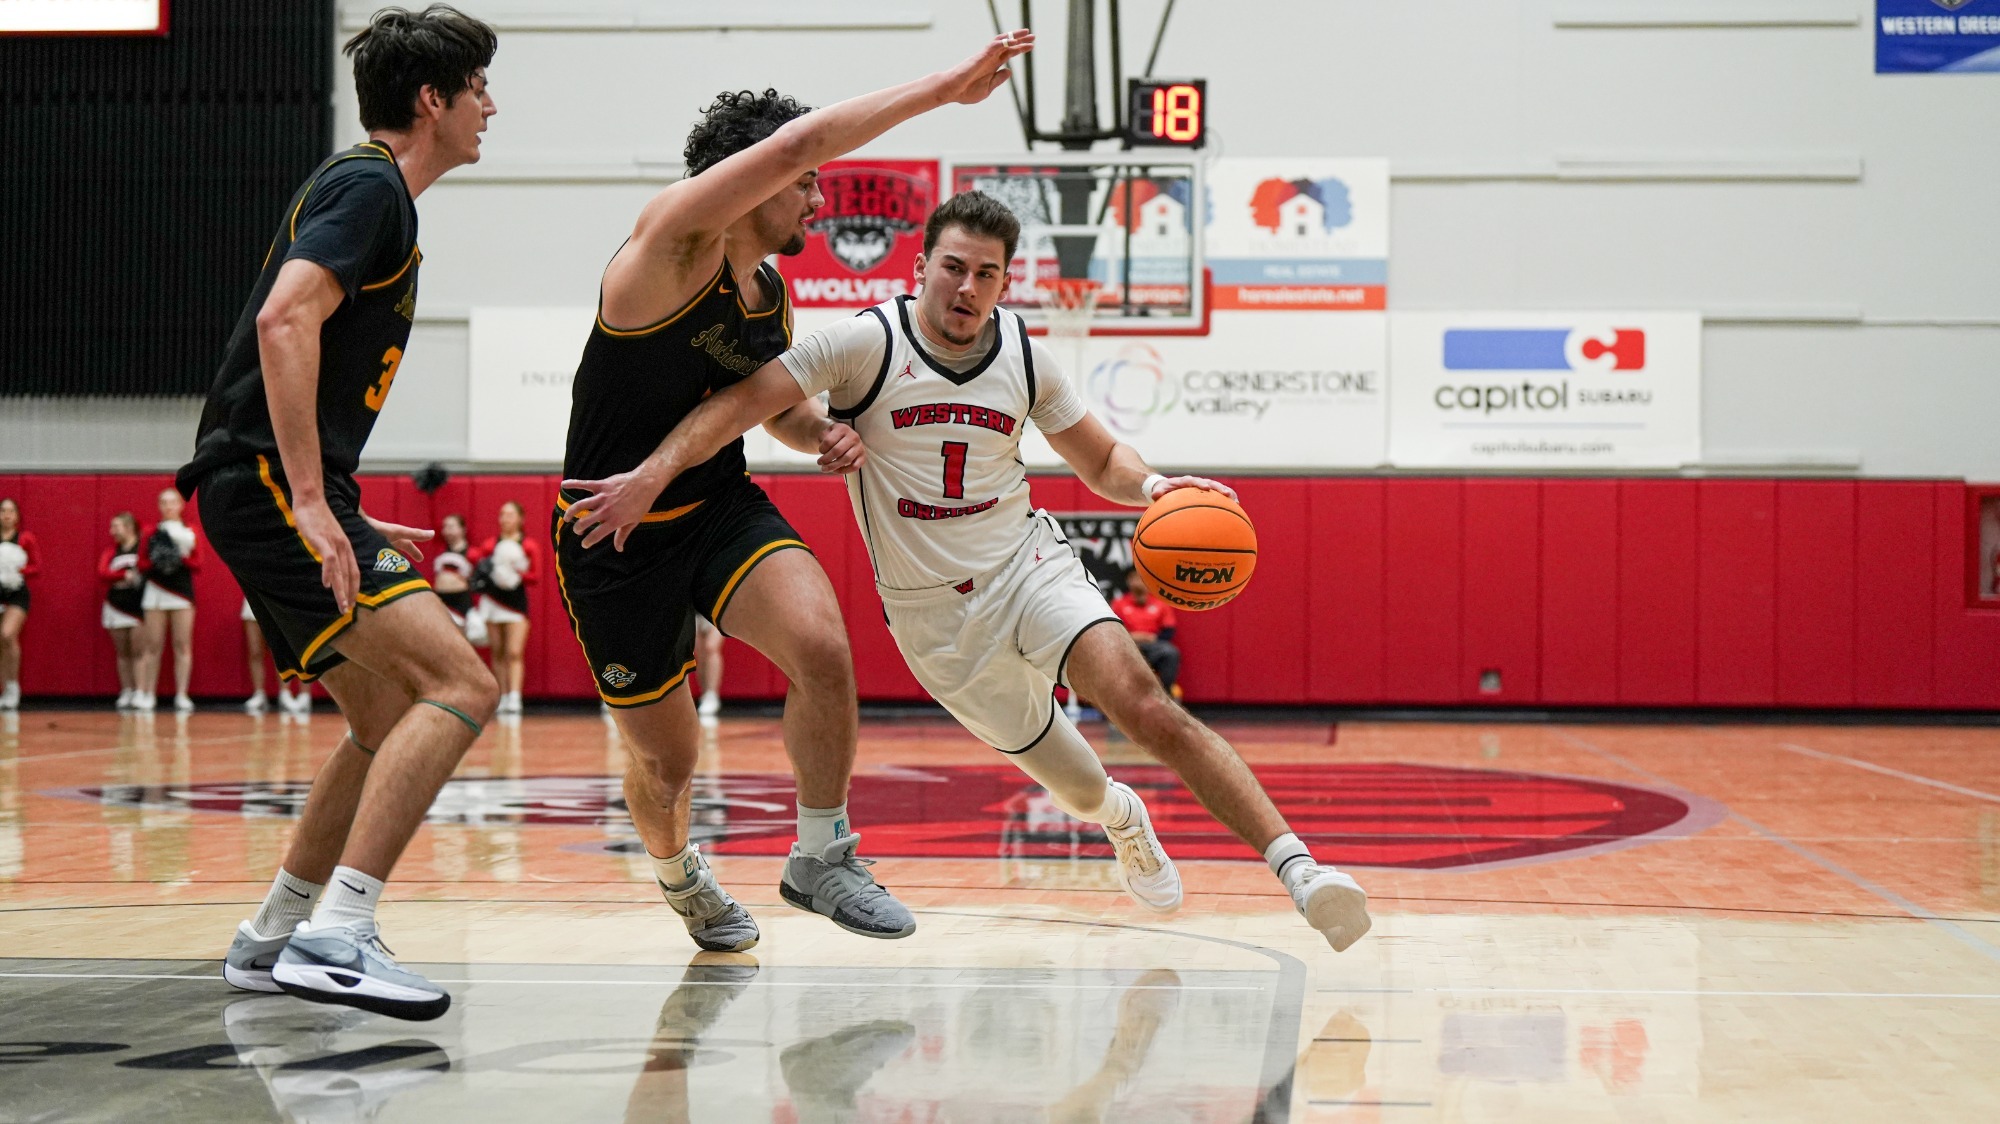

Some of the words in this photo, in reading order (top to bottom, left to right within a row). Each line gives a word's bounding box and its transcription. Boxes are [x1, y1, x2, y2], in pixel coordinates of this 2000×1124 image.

[1881, 16, 1957, 35] WESTERN
[1958, 15, 2000, 34] OREG
[1153, 86, 1199, 140] 18
[793, 278, 907, 301] WOLVES
[365, 346, 402, 412] 3
[1183, 370, 1378, 394] CORNERSTONE
[1434, 380, 1568, 415] capitol
[1578, 390, 1653, 404] SUBARU
[891, 403, 1016, 437] WESTERN
[1184, 398, 1270, 422] valley
[1471, 440, 1615, 455] capitolsubaru.com
[941, 441, 968, 499] 1
[1175, 565, 1235, 584] NCAA
